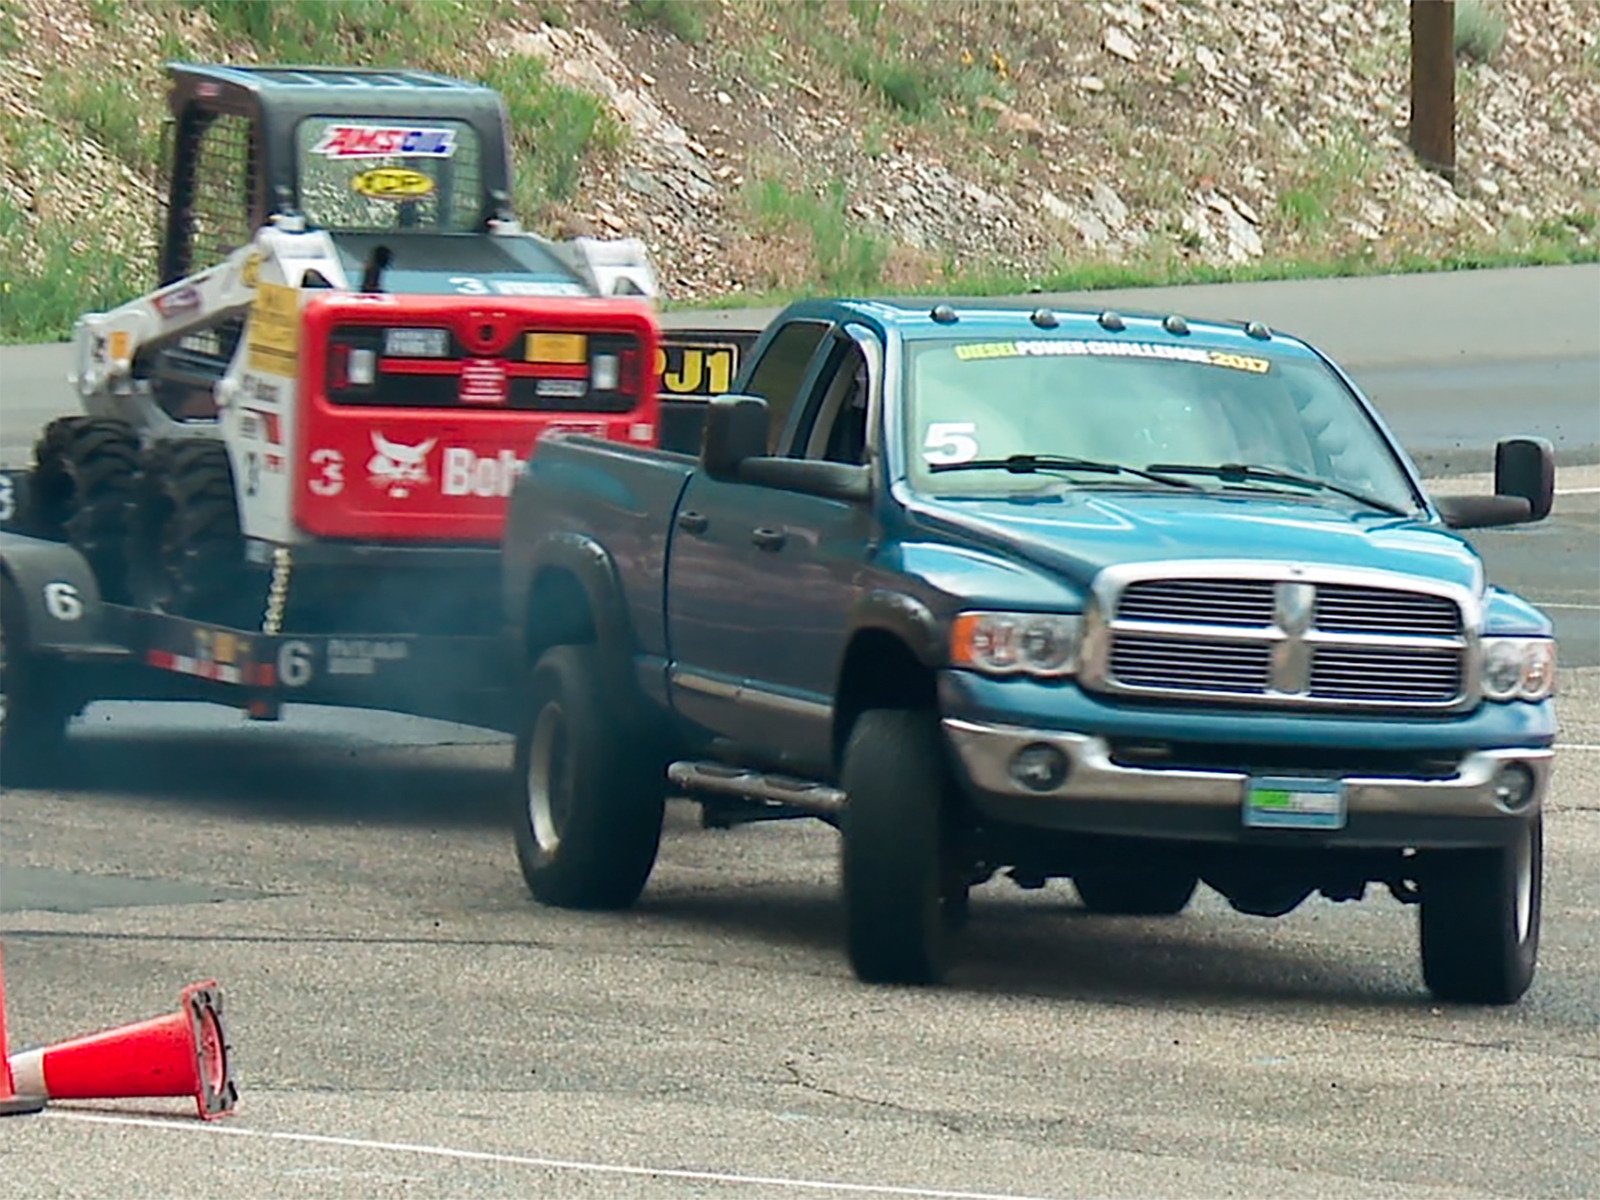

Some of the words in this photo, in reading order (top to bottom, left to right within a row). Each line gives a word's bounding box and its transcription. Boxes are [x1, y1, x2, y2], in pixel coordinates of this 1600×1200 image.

[449, 276, 491, 295] 3
[922, 422, 978, 464] 5
[308, 448, 345, 496] 3
[44, 582, 82, 620] 6
[278, 640, 313, 687] 6
